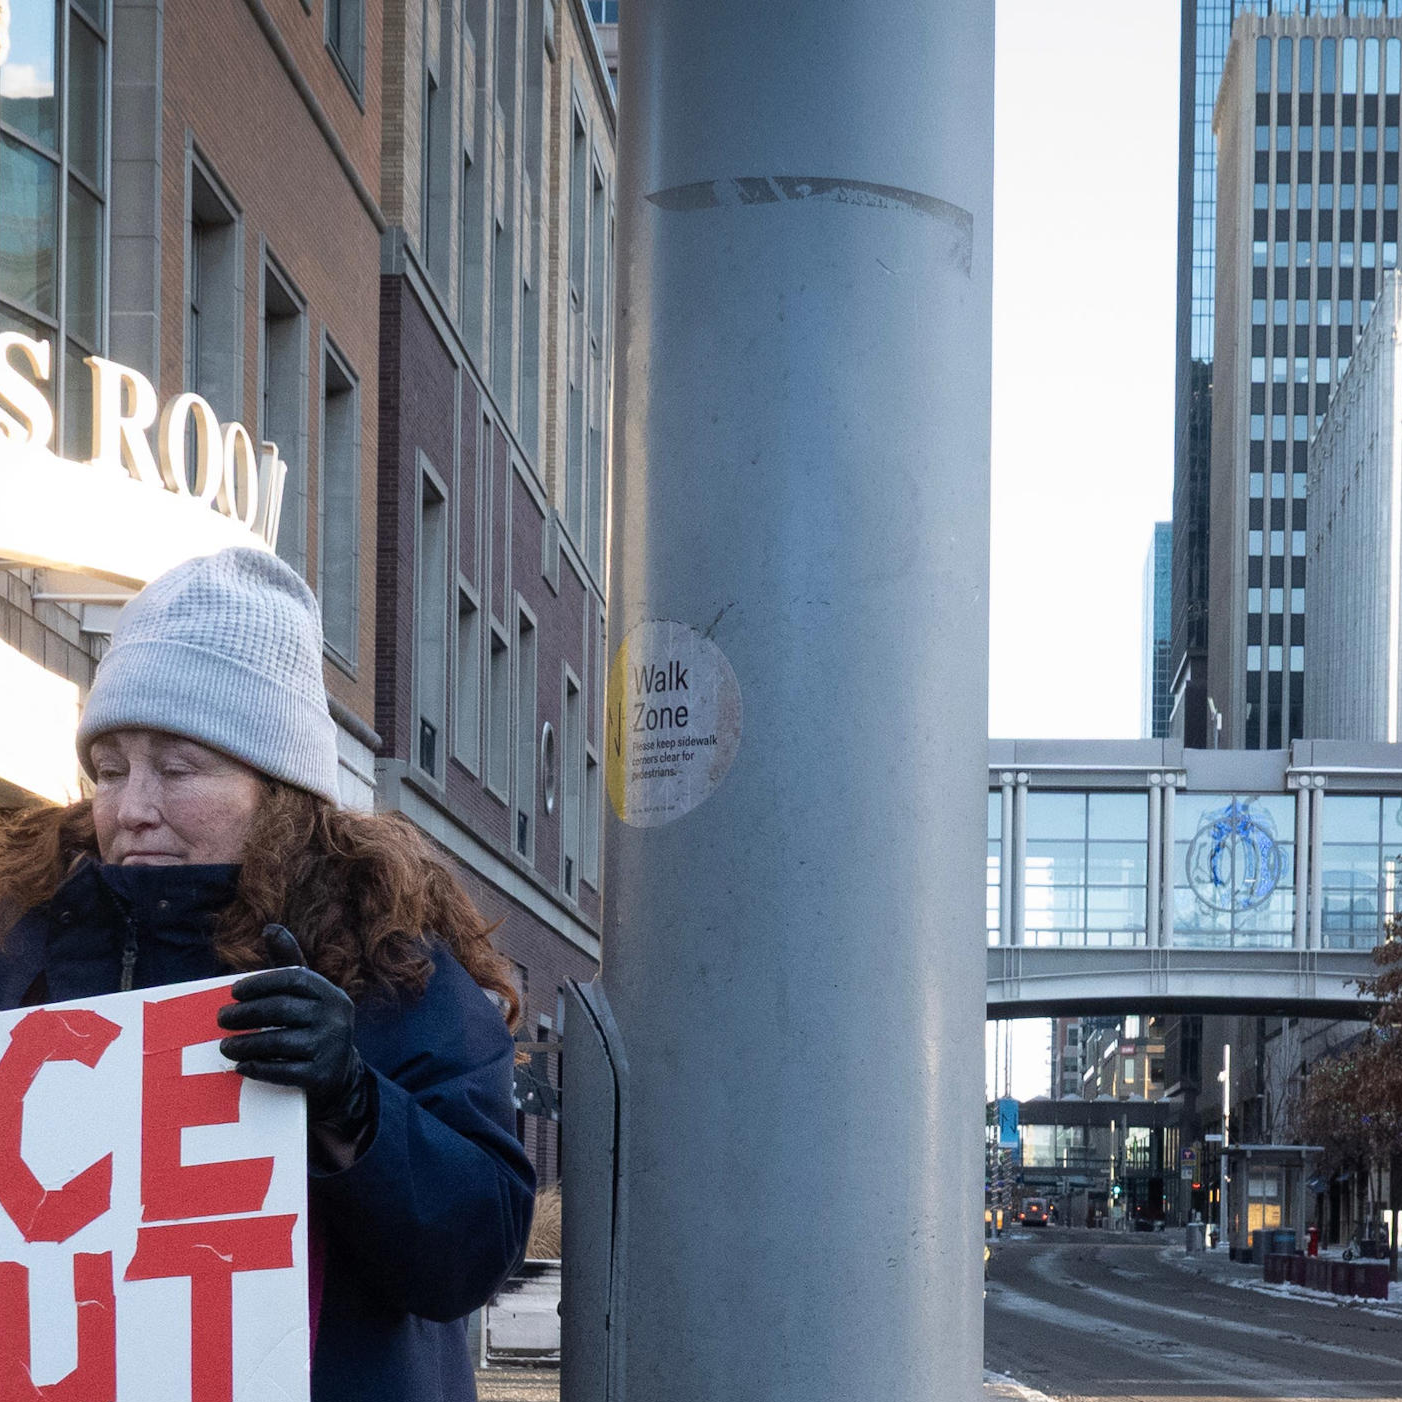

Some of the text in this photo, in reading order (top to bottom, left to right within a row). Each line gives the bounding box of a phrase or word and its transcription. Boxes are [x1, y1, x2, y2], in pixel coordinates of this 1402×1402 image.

[633, 660, 690, 695] Walk
[632, 703, 690, 733] Zone
[632, 734, 718, 752] Please keep sidewalk
[632, 750, 695, 766] corners clear for
